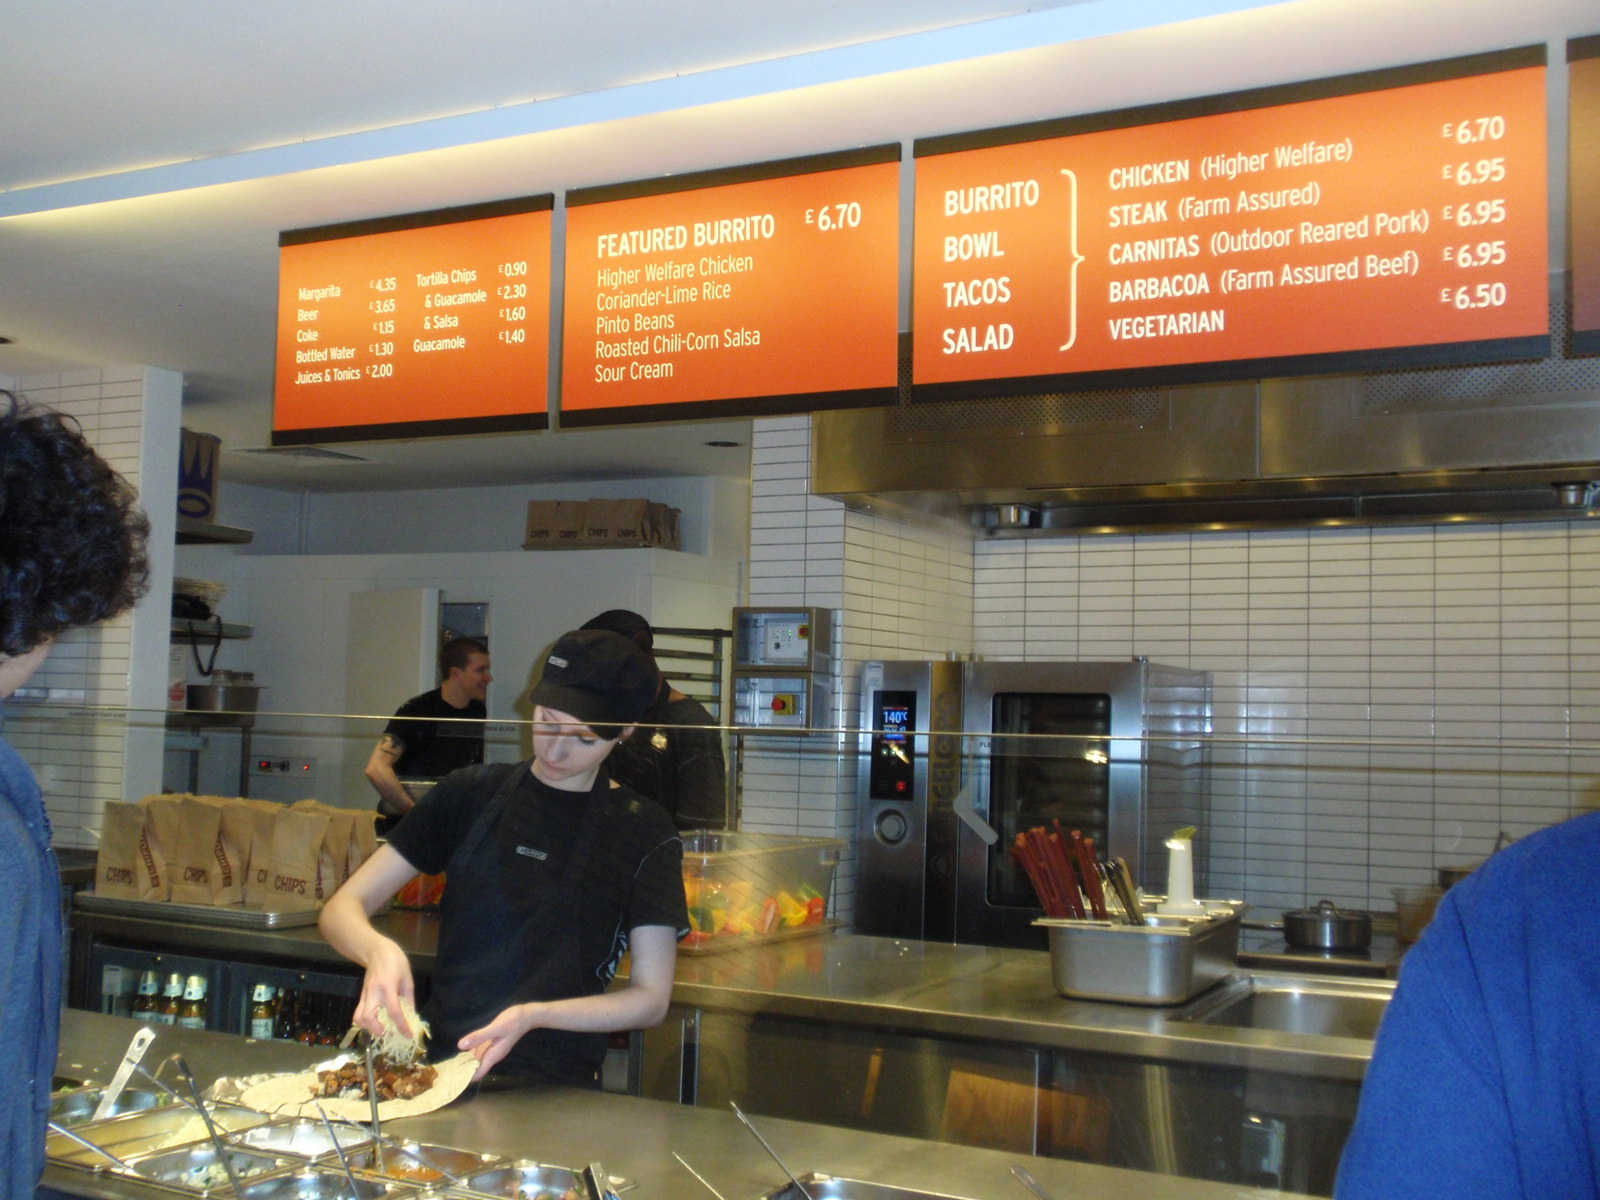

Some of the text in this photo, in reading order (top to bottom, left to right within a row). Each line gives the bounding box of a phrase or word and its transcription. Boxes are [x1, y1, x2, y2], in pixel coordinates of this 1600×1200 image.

[1109, 116, 1505, 190] CHICKEN (Higher Welfare) £6.70
[945, 180, 1039, 216] BURRITO
[1109, 158, 1505, 227] STEAK (Farm Assured) £6.95
[598, 202, 861, 258] FEATURED BURRITO £6.70
[1109, 199, 1506, 265] CARNITAS (Outdoor Reared Pork) £6.95
[945, 232, 1004, 261] BOWL
[417, 261, 527, 287] Tortilla Chips £0.90
[598, 255, 753, 289] Higher Welfare Chicken
[1110, 241, 1506, 302] BARBACOA (Farm Assured Beef) £6.95
[299, 277, 396, 301] Margarita £4.35
[425, 284, 526, 307] & Guacamole £2.30
[597, 282, 731, 311] Coriander-Lime Rice
[944, 277, 1011, 307] TACOS
[298, 299, 395, 321] Beer £3.65
[424, 306, 526, 329] & Salsa £1.60
[1109, 283, 1506, 339] VEGETARIAN £6.50
[297, 320, 394, 342] Coke £1.15
[597, 313, 674, 334] Pinto Beans
[414, 329, 525, 352] Guacamole £1.40
[596, 328, 760, 358] Roasted Chili-Corn Salsa
[943, 324, 1014, 354] SALAD
[297, 342, 393, 363] Bottled Water £1.30
[295, 364, 393, 384] Juices & Tonics £2.00
[595, 362, 672, 382] Sour Cream
[105, 867, 133, 885] CHIPS
[183, 866, 208, 884] CHIPS
[274, 875, 306, 895] CHIPS
